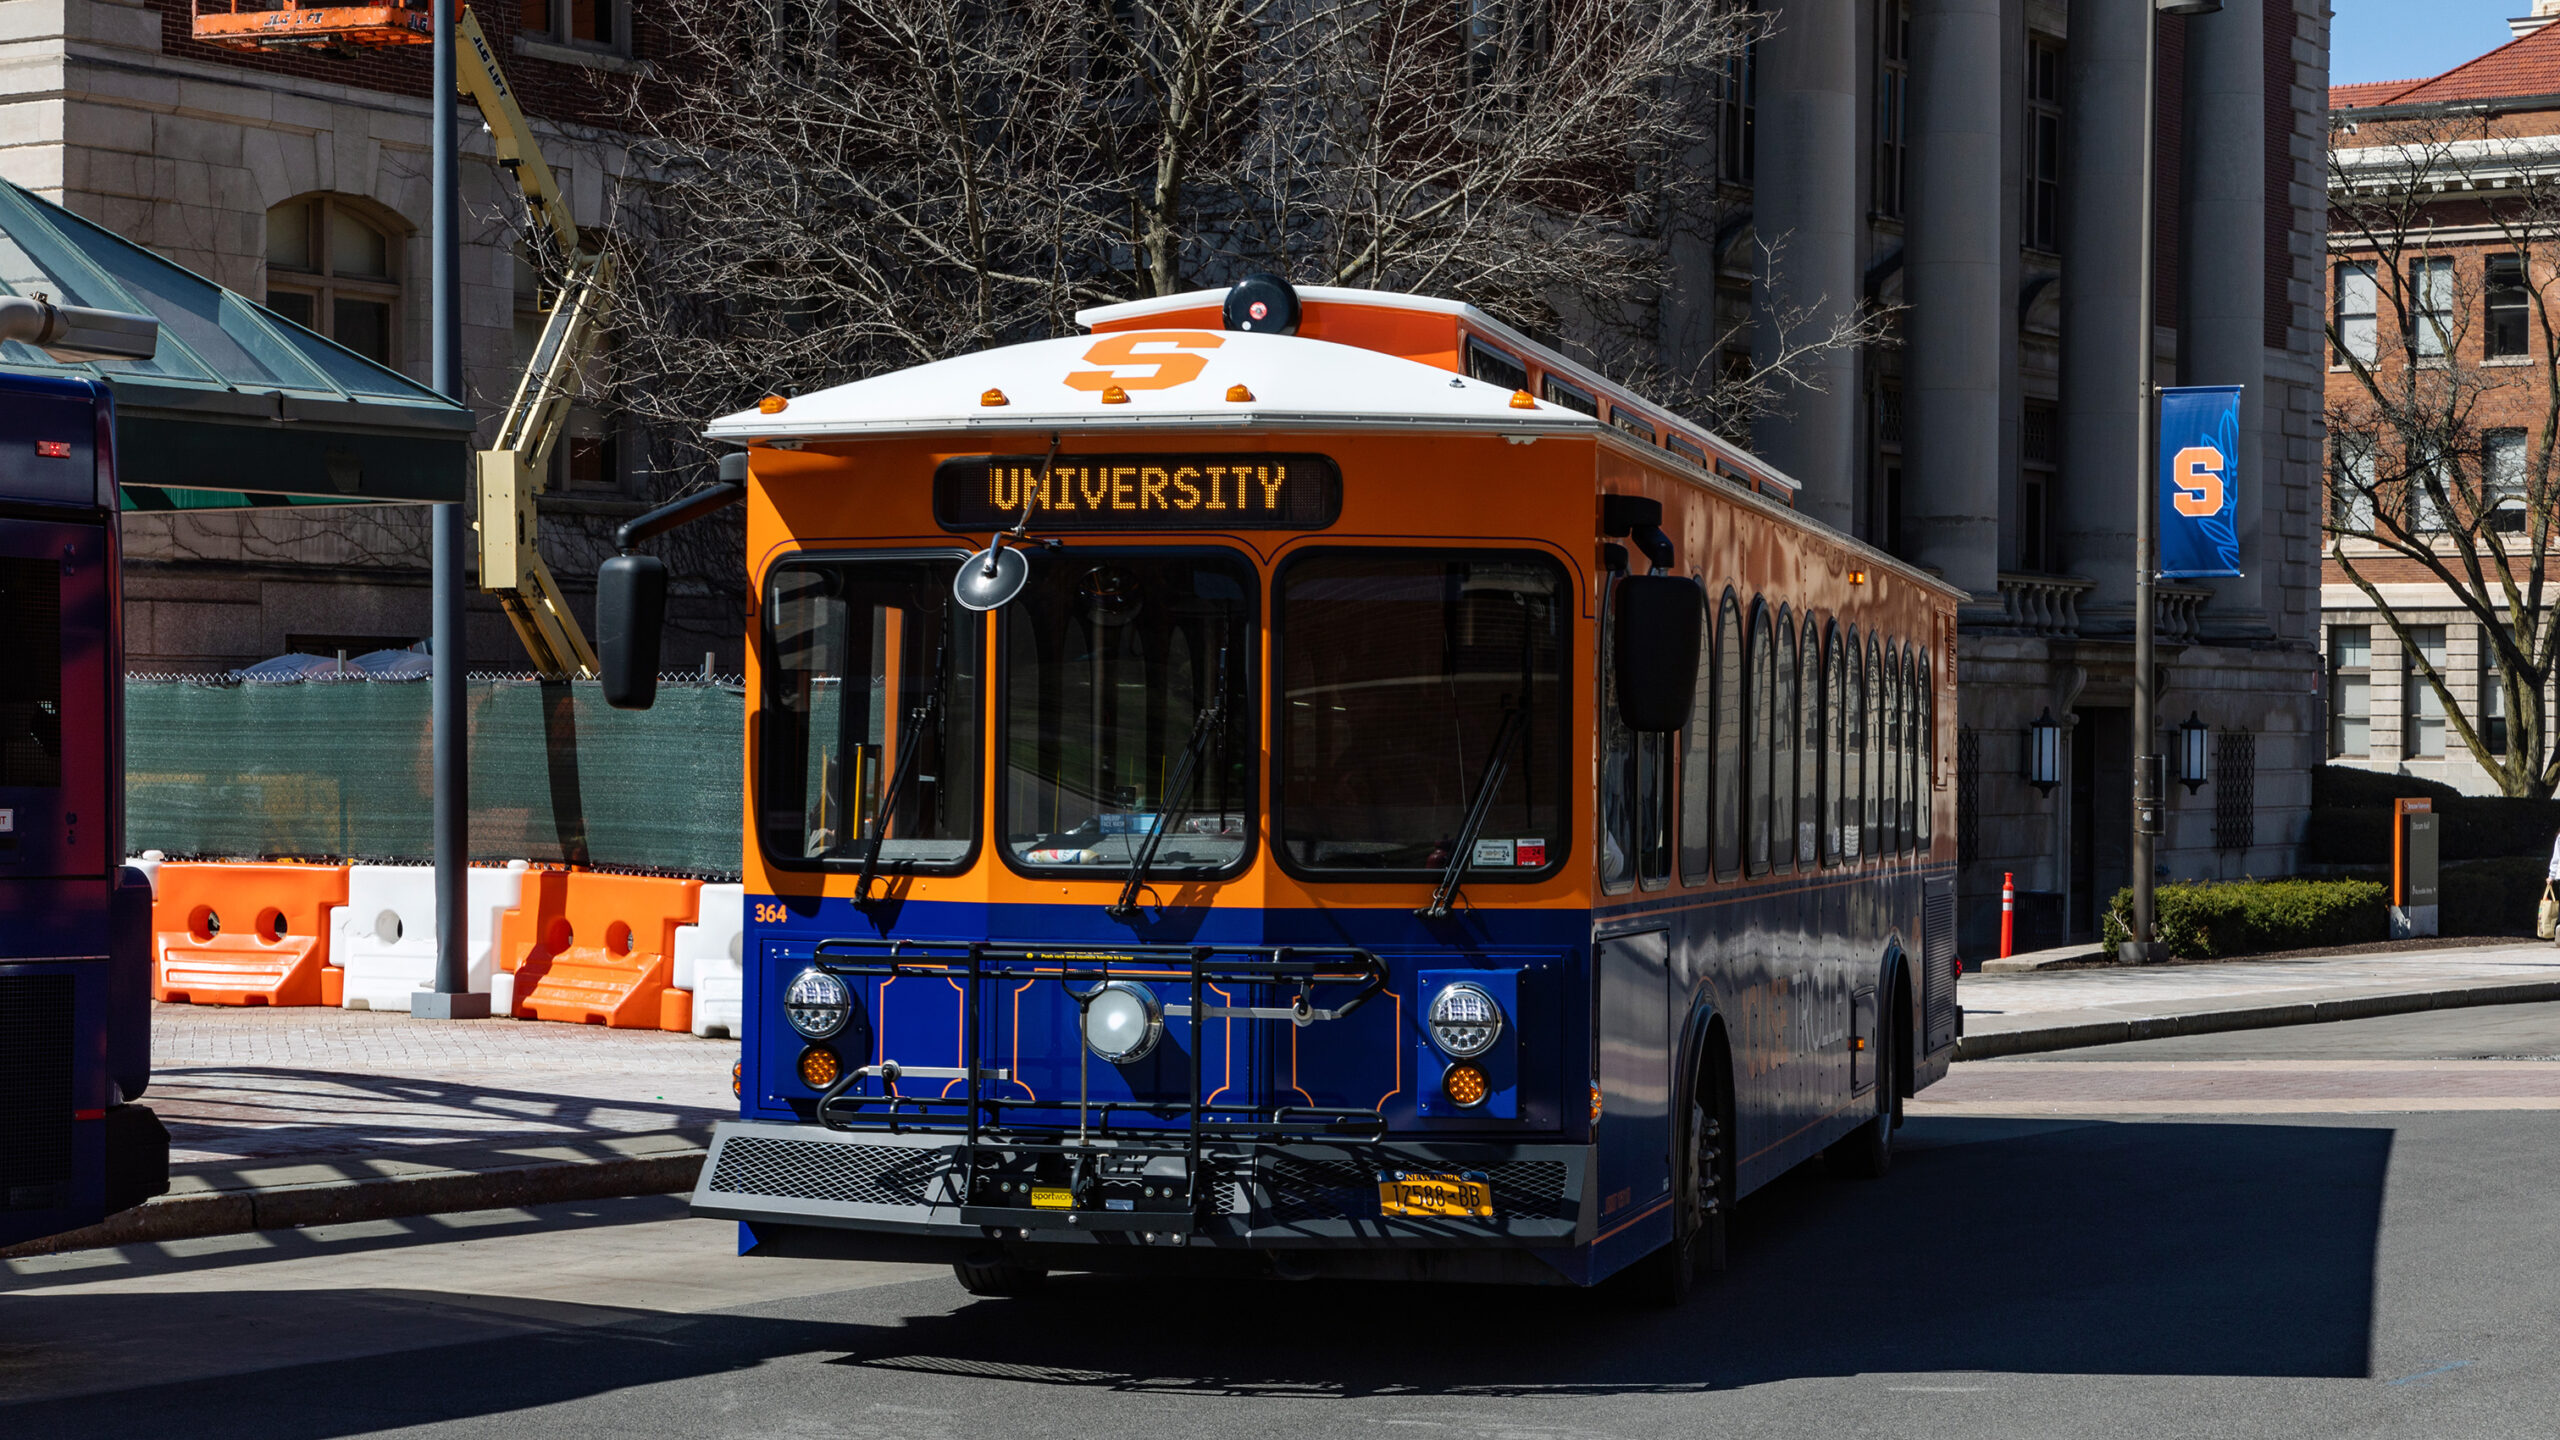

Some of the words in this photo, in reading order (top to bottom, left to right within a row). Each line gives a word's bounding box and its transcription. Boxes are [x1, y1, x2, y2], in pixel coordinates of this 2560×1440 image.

[473, 36, 491, 63] JLG
[488, 64, 508, 97] LIFT
[1063, 331, 1226, 391] S
[994, 466, 1286, 510] UNIVERSITY
[2174, 446, 2224, 517] S
[754, 903, 787, 923] 364
[1792, 957, 1853, 1058] TROLLEY
[1405, 1174, 1431, 1182] NEW
[1434, 1174, 1462, 1182] YORK
